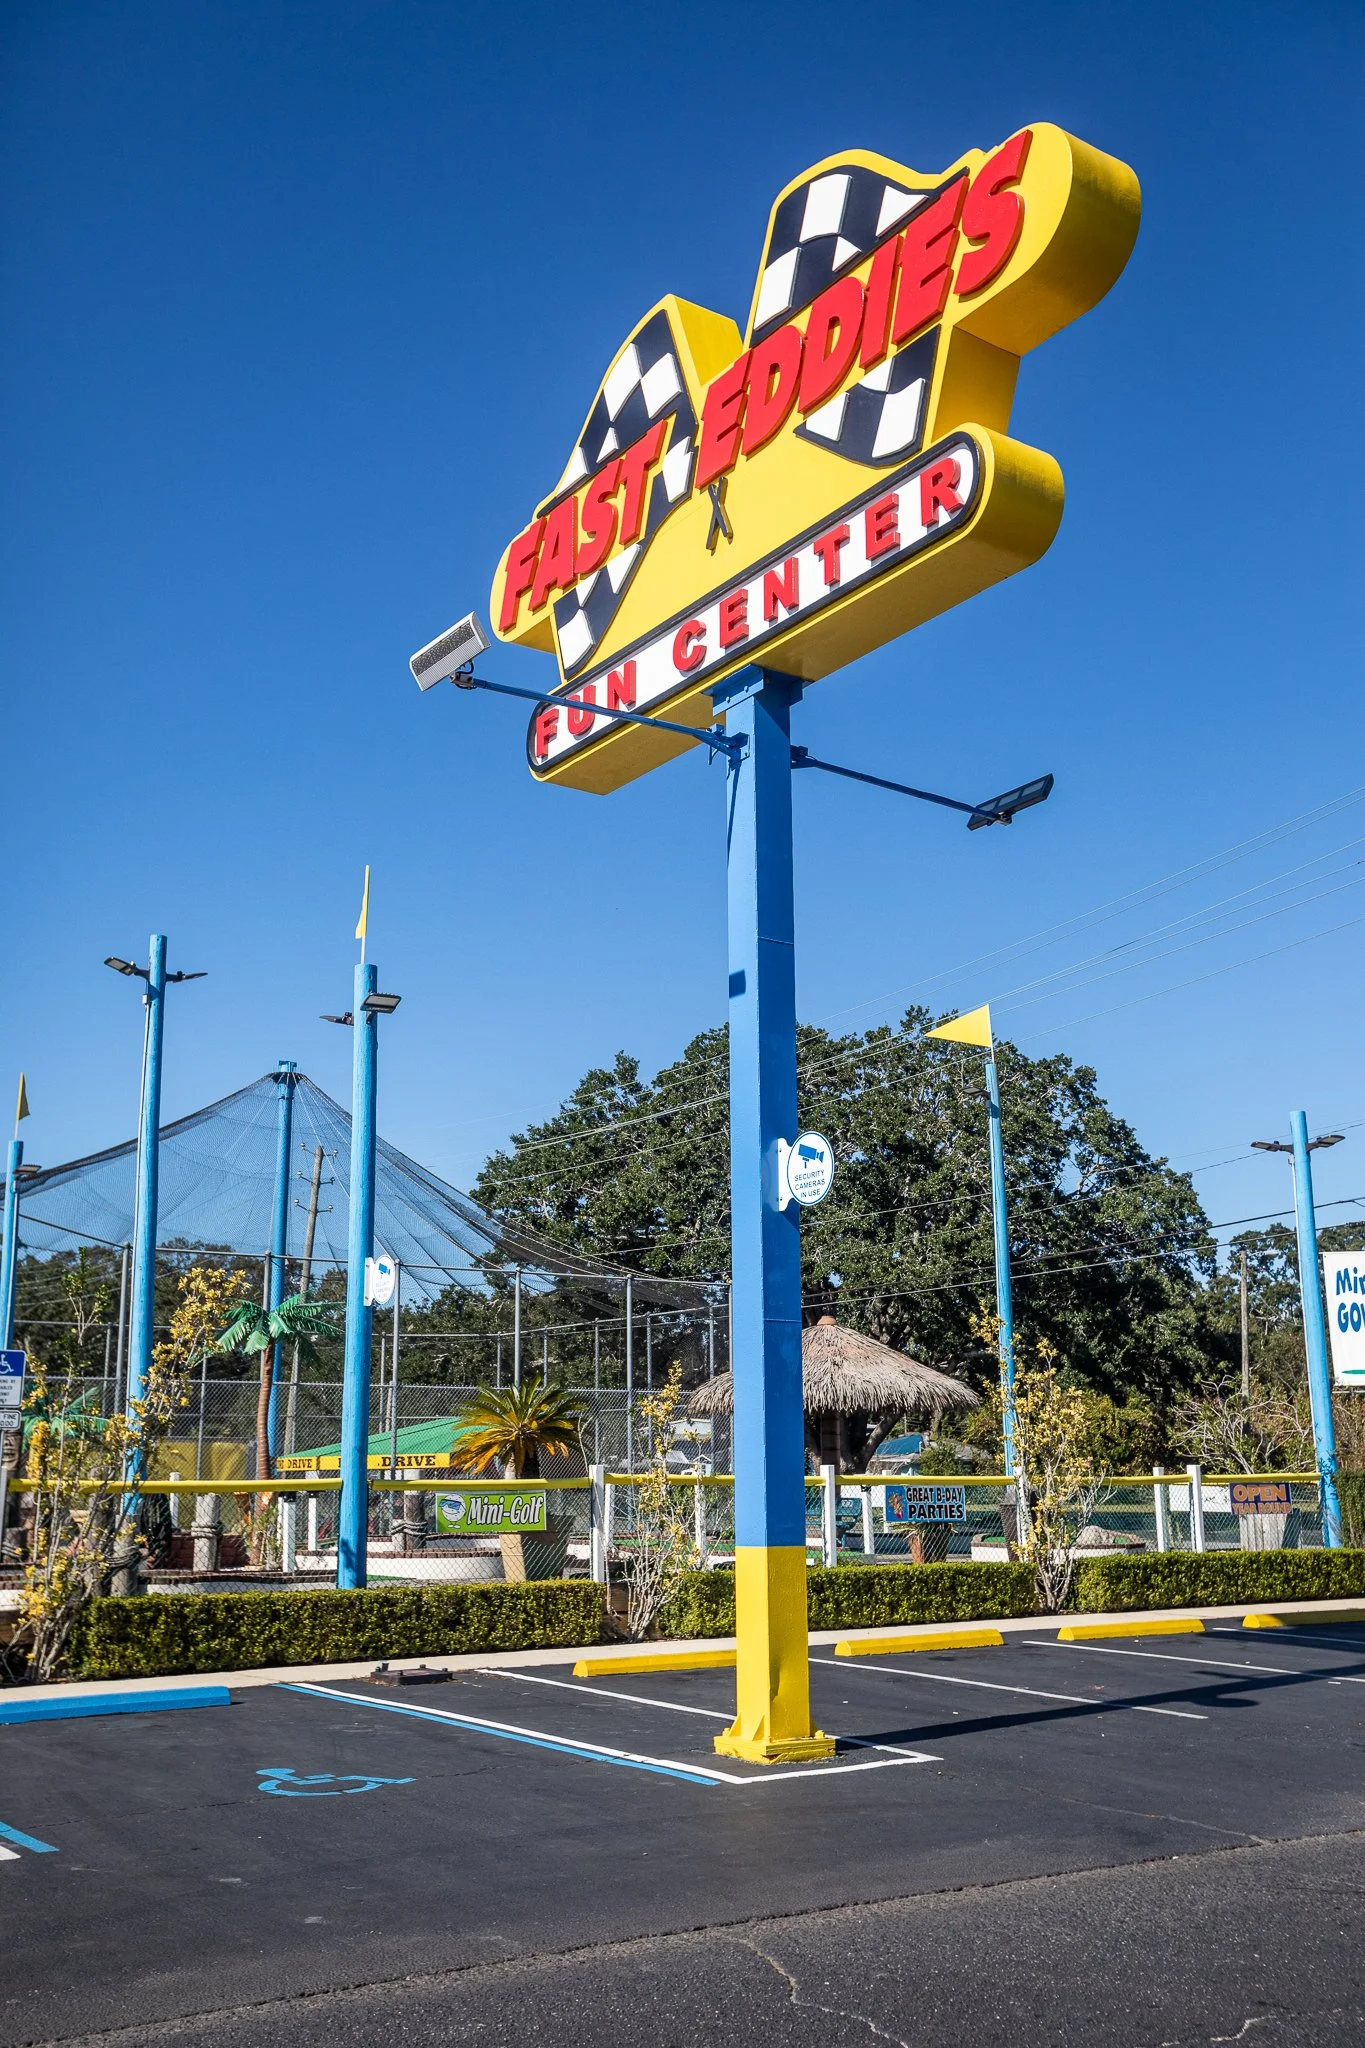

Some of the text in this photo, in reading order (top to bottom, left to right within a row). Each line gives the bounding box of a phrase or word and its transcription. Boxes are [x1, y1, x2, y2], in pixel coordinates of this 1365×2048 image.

[498, 129, 1033, 635] FAST EDDIES
[536, 457, 964, 760] FUN CENTER
[794, 1169, 825, 1182] SECURITY
[794, 1178, 826, 1191] CAMERAS
[807, 1188, 821, 1197] USE
[287, 1458, 312, 1469] DRIVE
[381, 1455, 436, 1467] DRIVE
[906, 1487, 963, 1502] GREAT B-DAY
[1233, 1484, 1287, 1502] OPEN
[467, 1495, 544, 1525] Mini-Golf
[908, 1504, 964, 1519] PARTIES
[1232, 1502, 1292, 1515] YEAR ROUND
